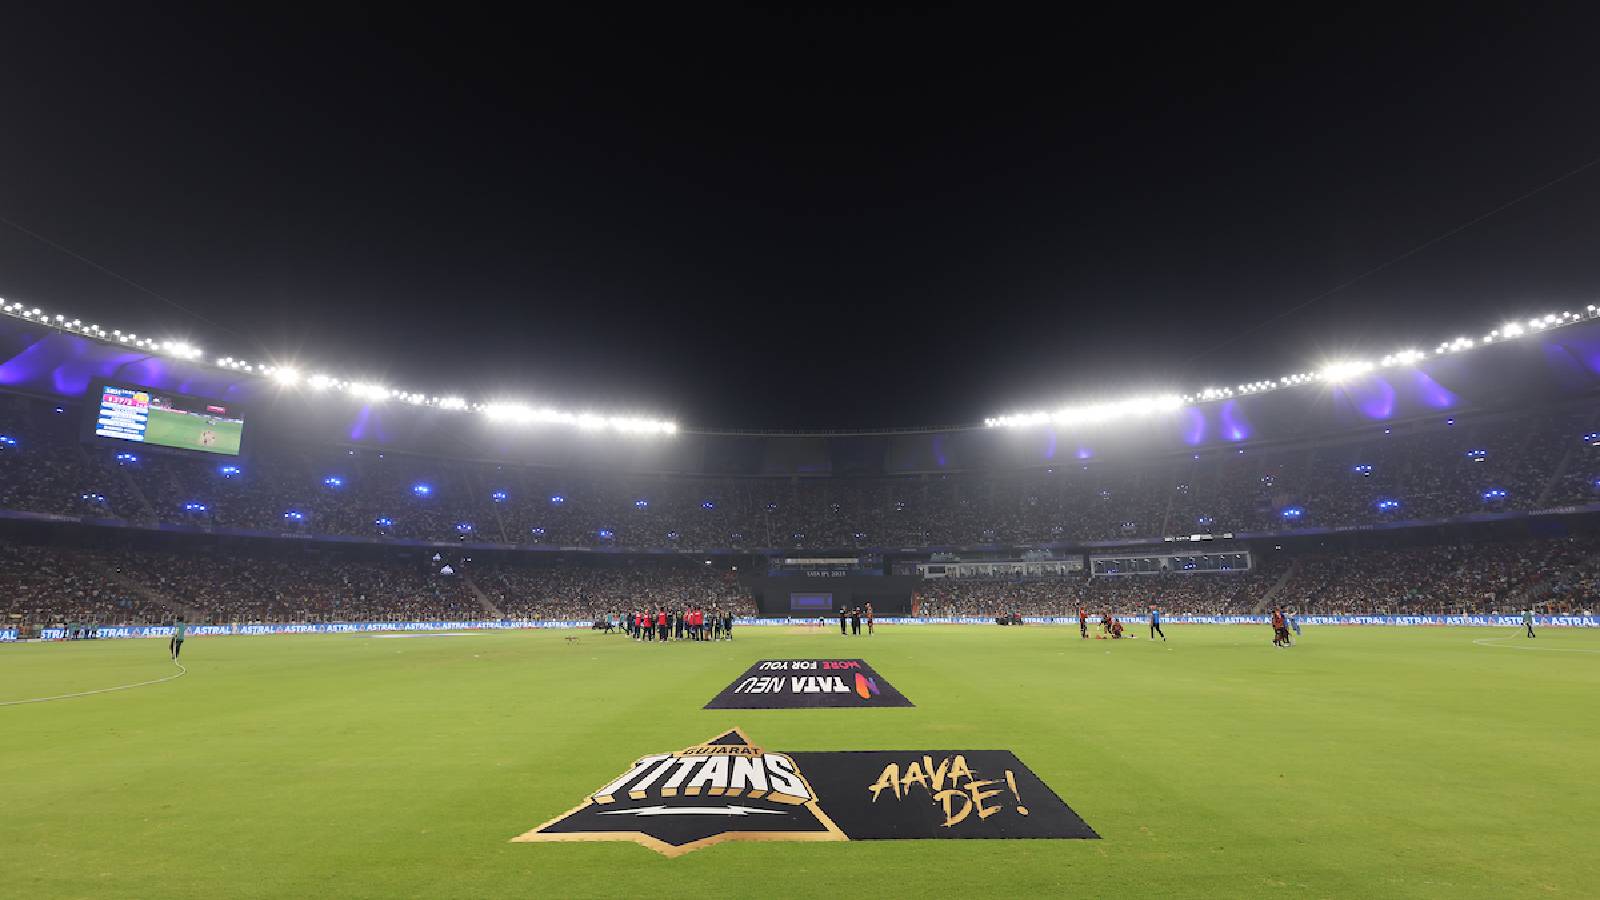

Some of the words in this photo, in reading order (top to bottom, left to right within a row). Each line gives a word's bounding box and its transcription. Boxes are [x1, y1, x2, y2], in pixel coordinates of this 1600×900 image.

[1446, 617, 1488, 625] ASTRAL
[1499, 617, 1540, 625] ASTRL
[1551, 617, 1600, 626] ASTRAL
[143, 628, 176, 636] ASTRA
[193, 626, 231, 634] ASTRAL
[759, 661, 788, 670] YOU
[792, 661, 817, 670] FOR
[823, 661, 861, 669] MORE
[734, 676, 786, 694] NEU
[791, 676, 850, 694] TATA
[683, 747, 761, 755] GUJARAT
[593, 754, 813, 803] TITANS
[868, 754, 976, 803] AAVA
[932, 769, 1029, 827] DE!
